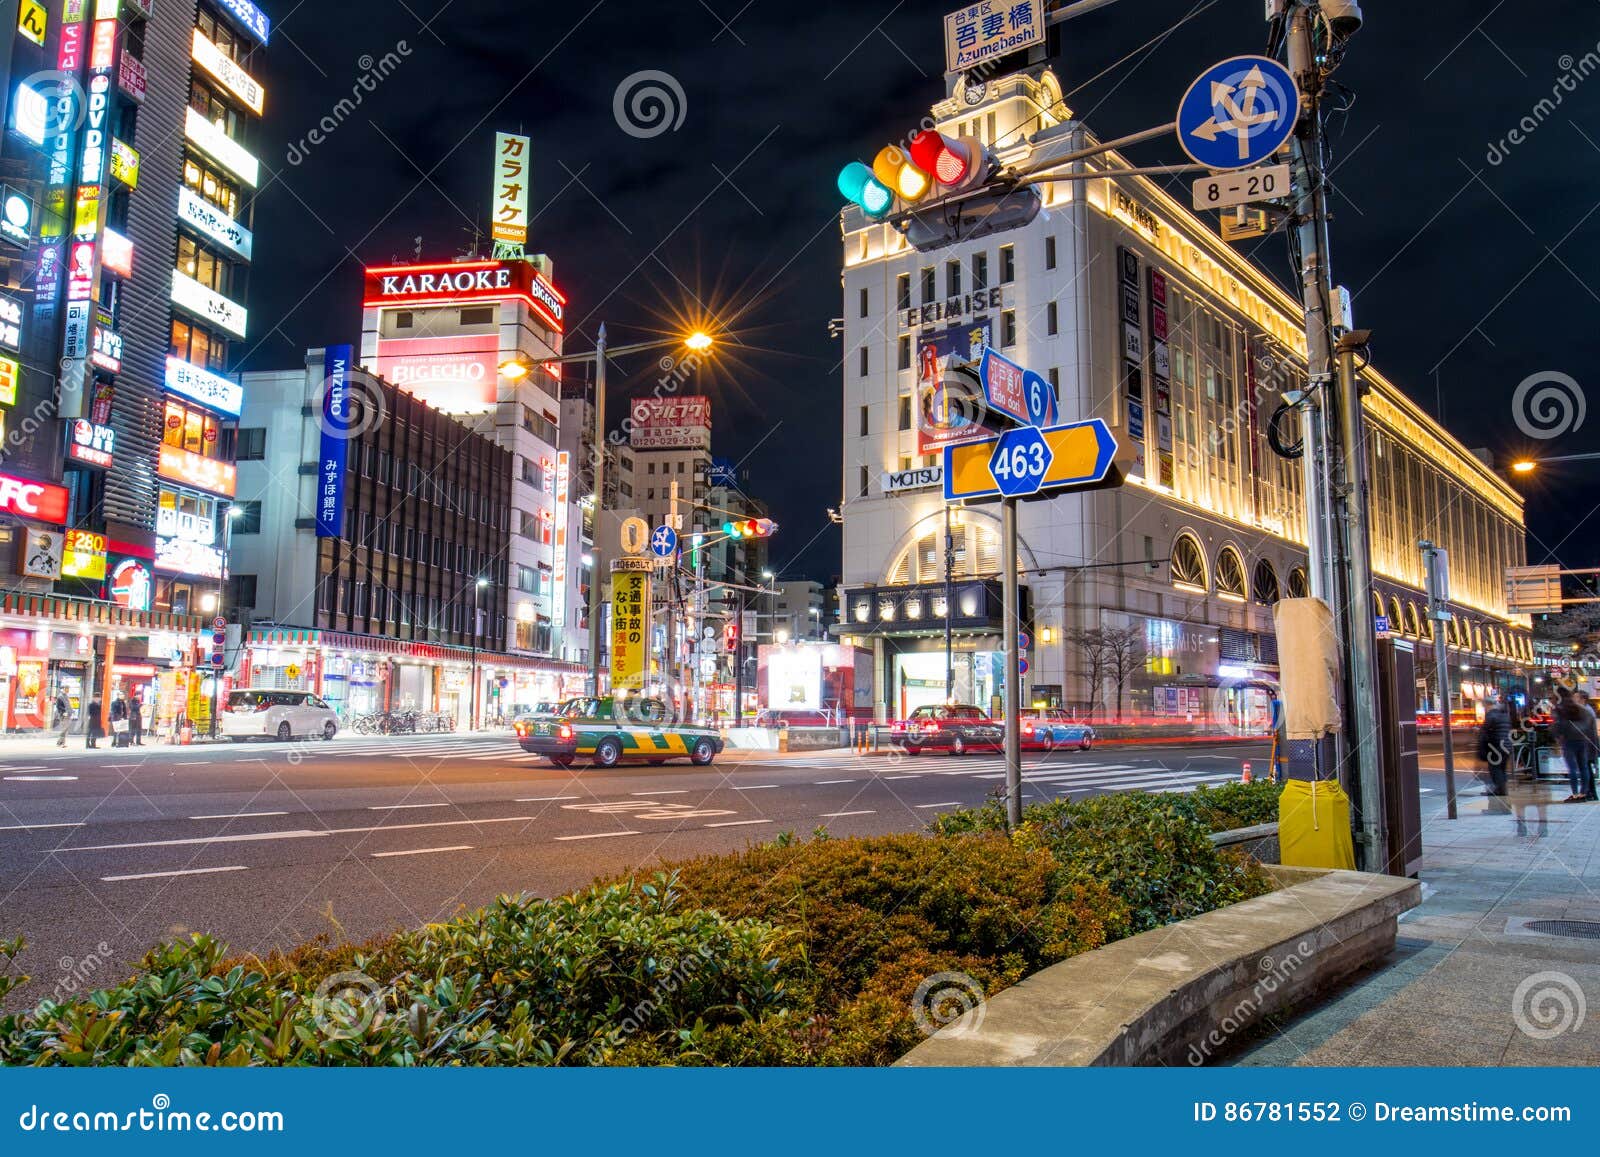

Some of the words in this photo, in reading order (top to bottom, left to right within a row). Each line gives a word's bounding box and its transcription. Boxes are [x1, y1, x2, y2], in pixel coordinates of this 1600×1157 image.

[954, 1, 993, 26] 台東区
[955, 1, 1033, 49] 吾妻橋
[956, 26, 1036, 66] Azumabashi
[501, 138, 524, 222] カラオケ
[382, 269, 511, 296] KARAOKE
[907, 287, 1002, 328] EKIMISE
[331, 359, 345, 417] MIZUHO
[1030, 381, 1042, 417] 6
[654, 404, 703, 419] マルフク
[995, 441, 1045, 480] 463
[0, 476, 45, 513] FC
[323, 459, 338, 521] みずほ銀行
[75, 532, 103, 551] 280
[629, 577, 642, 644] 交通事故の
[615, 591, 628, 672] ない街浅草を
